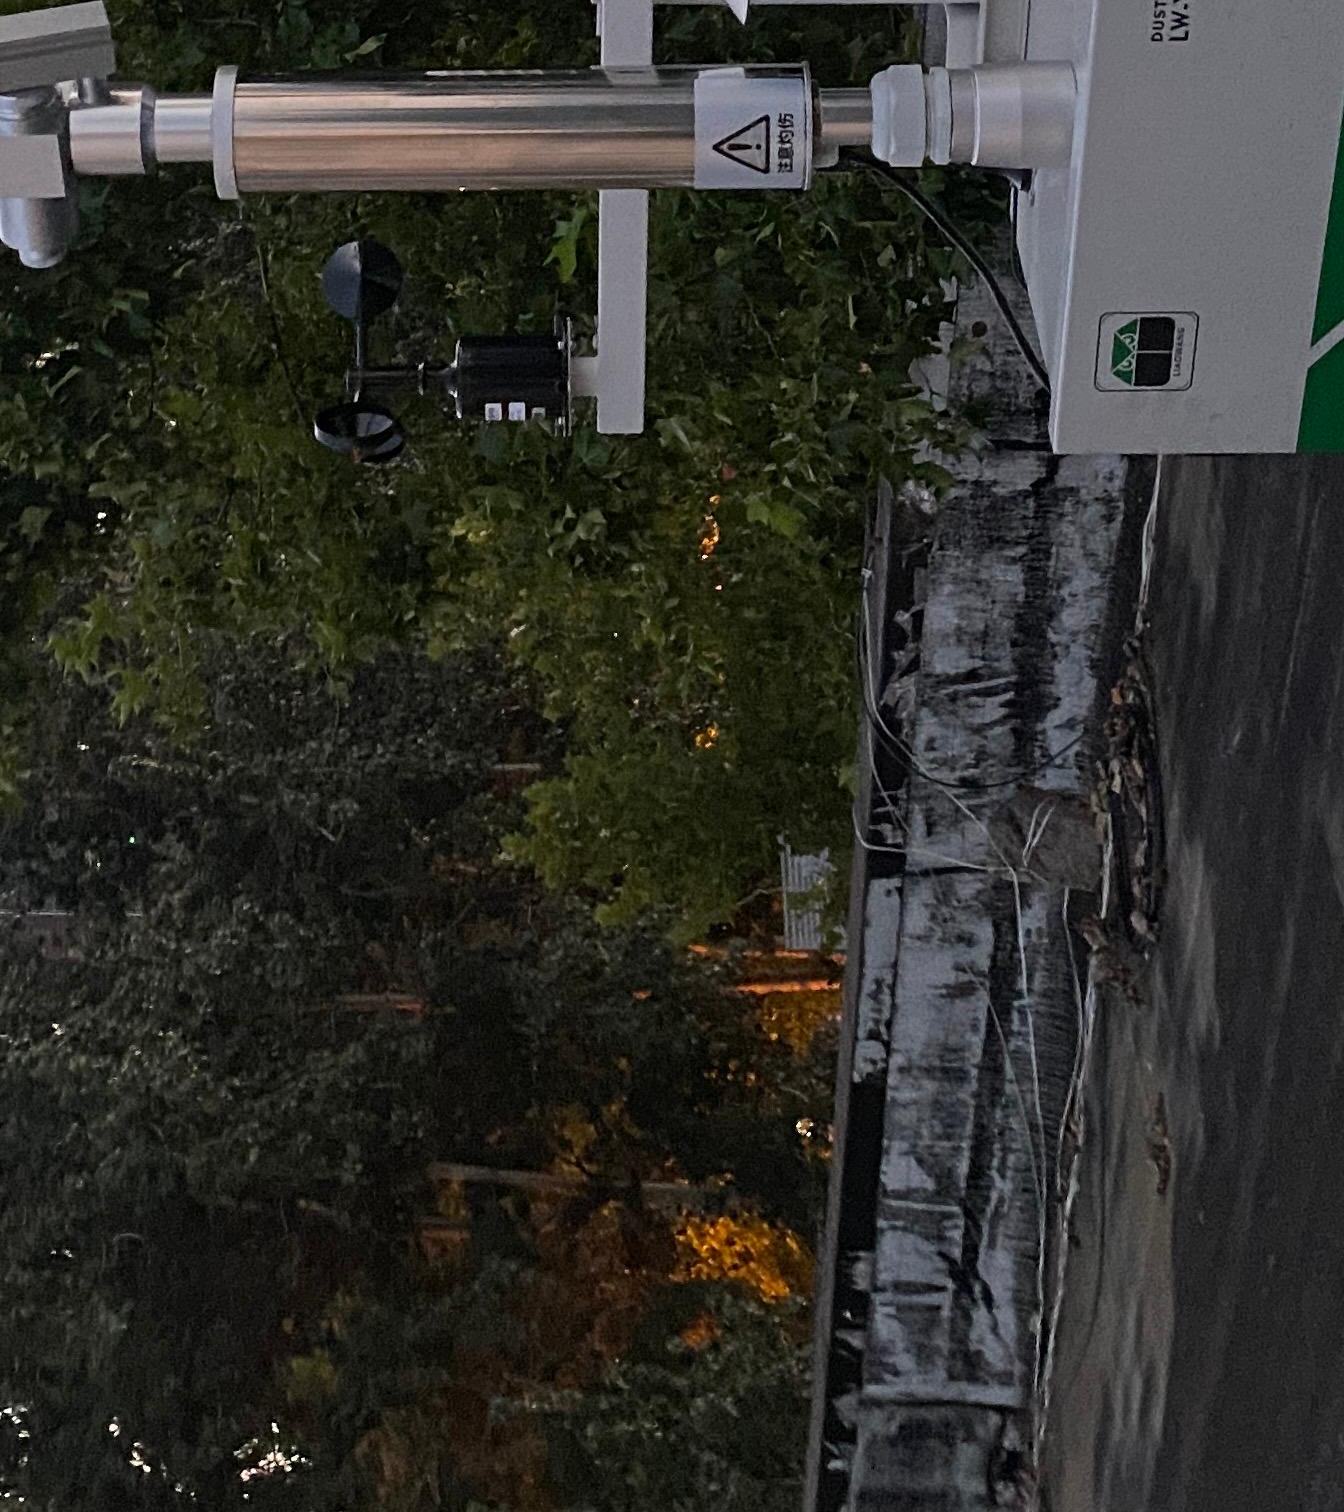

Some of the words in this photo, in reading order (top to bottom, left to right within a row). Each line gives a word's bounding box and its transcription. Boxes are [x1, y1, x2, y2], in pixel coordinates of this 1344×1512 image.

[1151, 0, 1167, 42] DUST
[777, 112, 795, 173] 注意灼伤
